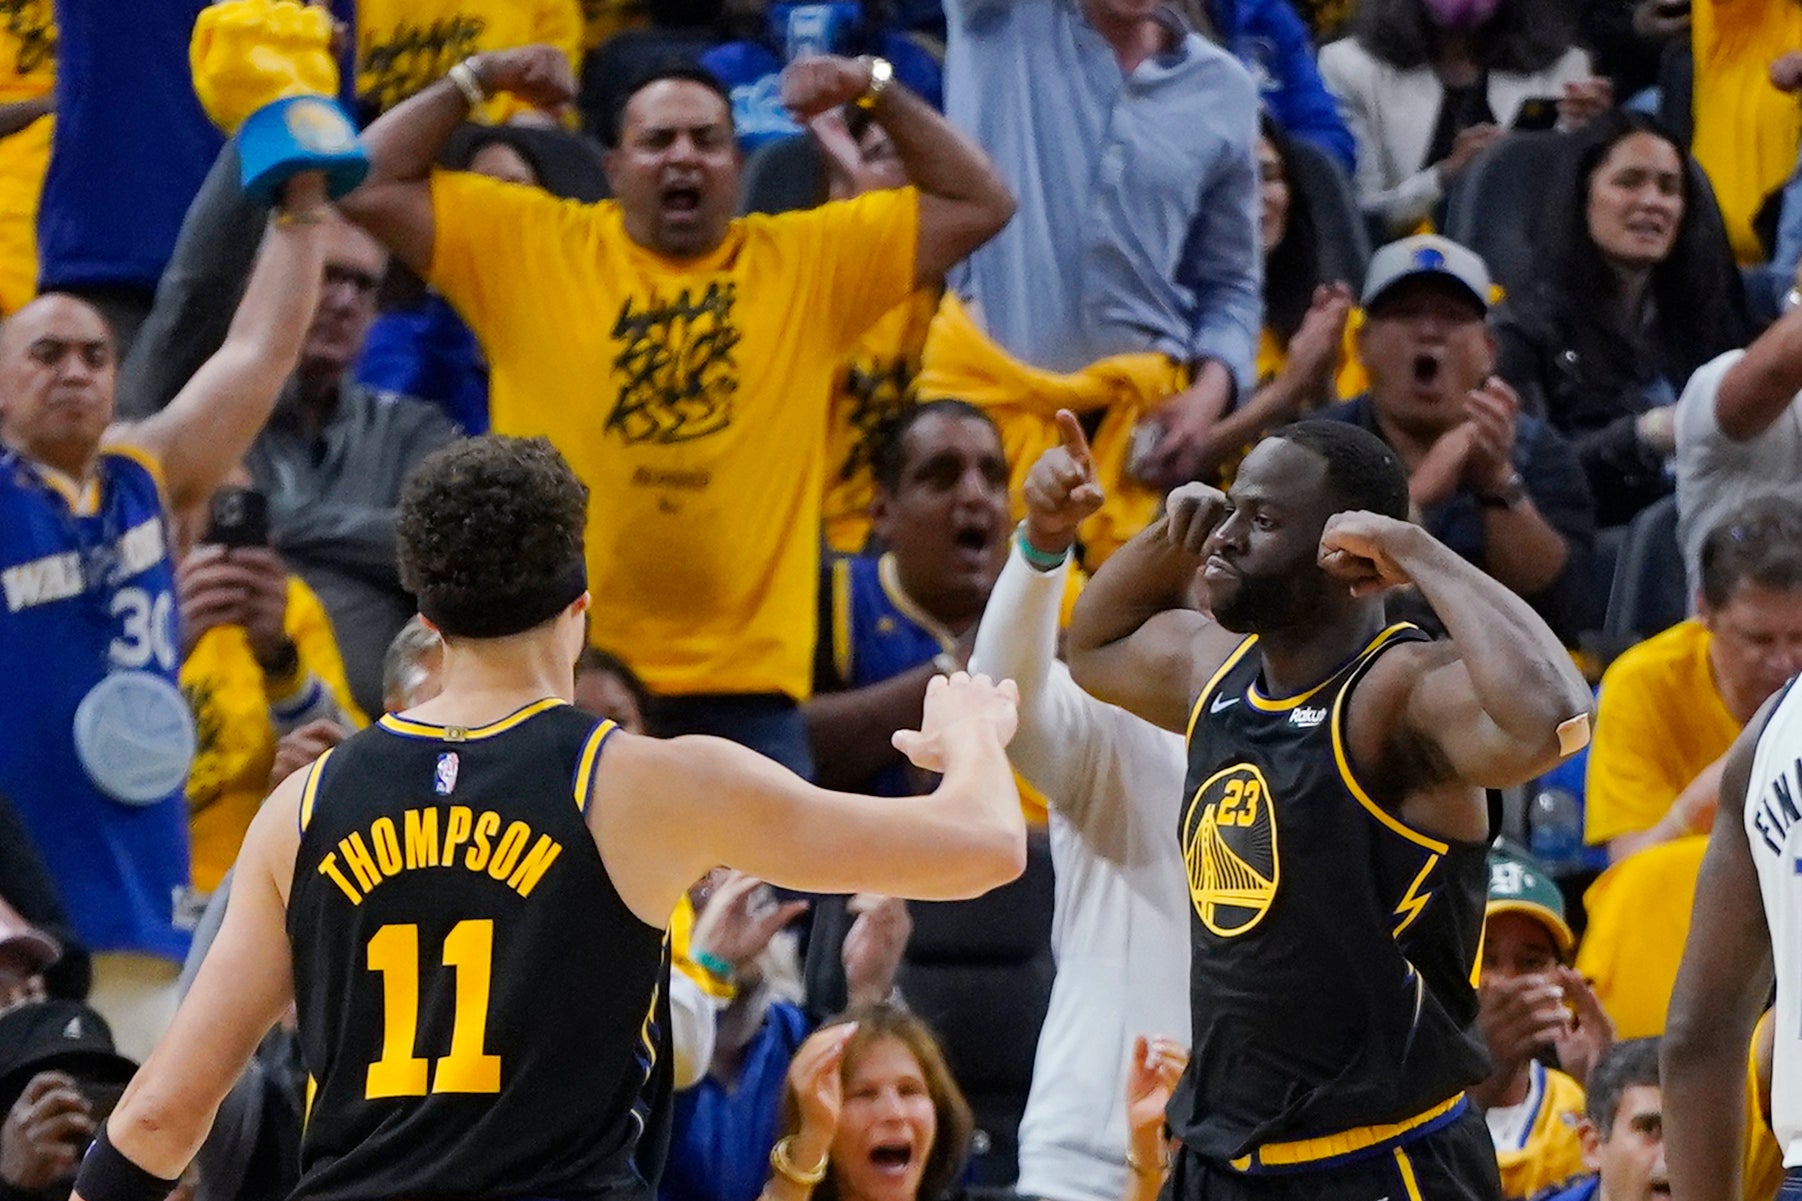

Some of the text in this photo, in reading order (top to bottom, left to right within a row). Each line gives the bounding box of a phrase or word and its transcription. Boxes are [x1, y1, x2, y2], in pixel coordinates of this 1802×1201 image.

[1216, 779, 1260, 827] 23
[318, 806, 563, 906] THOMPSON
[365, 919, 501, 1100] 11
